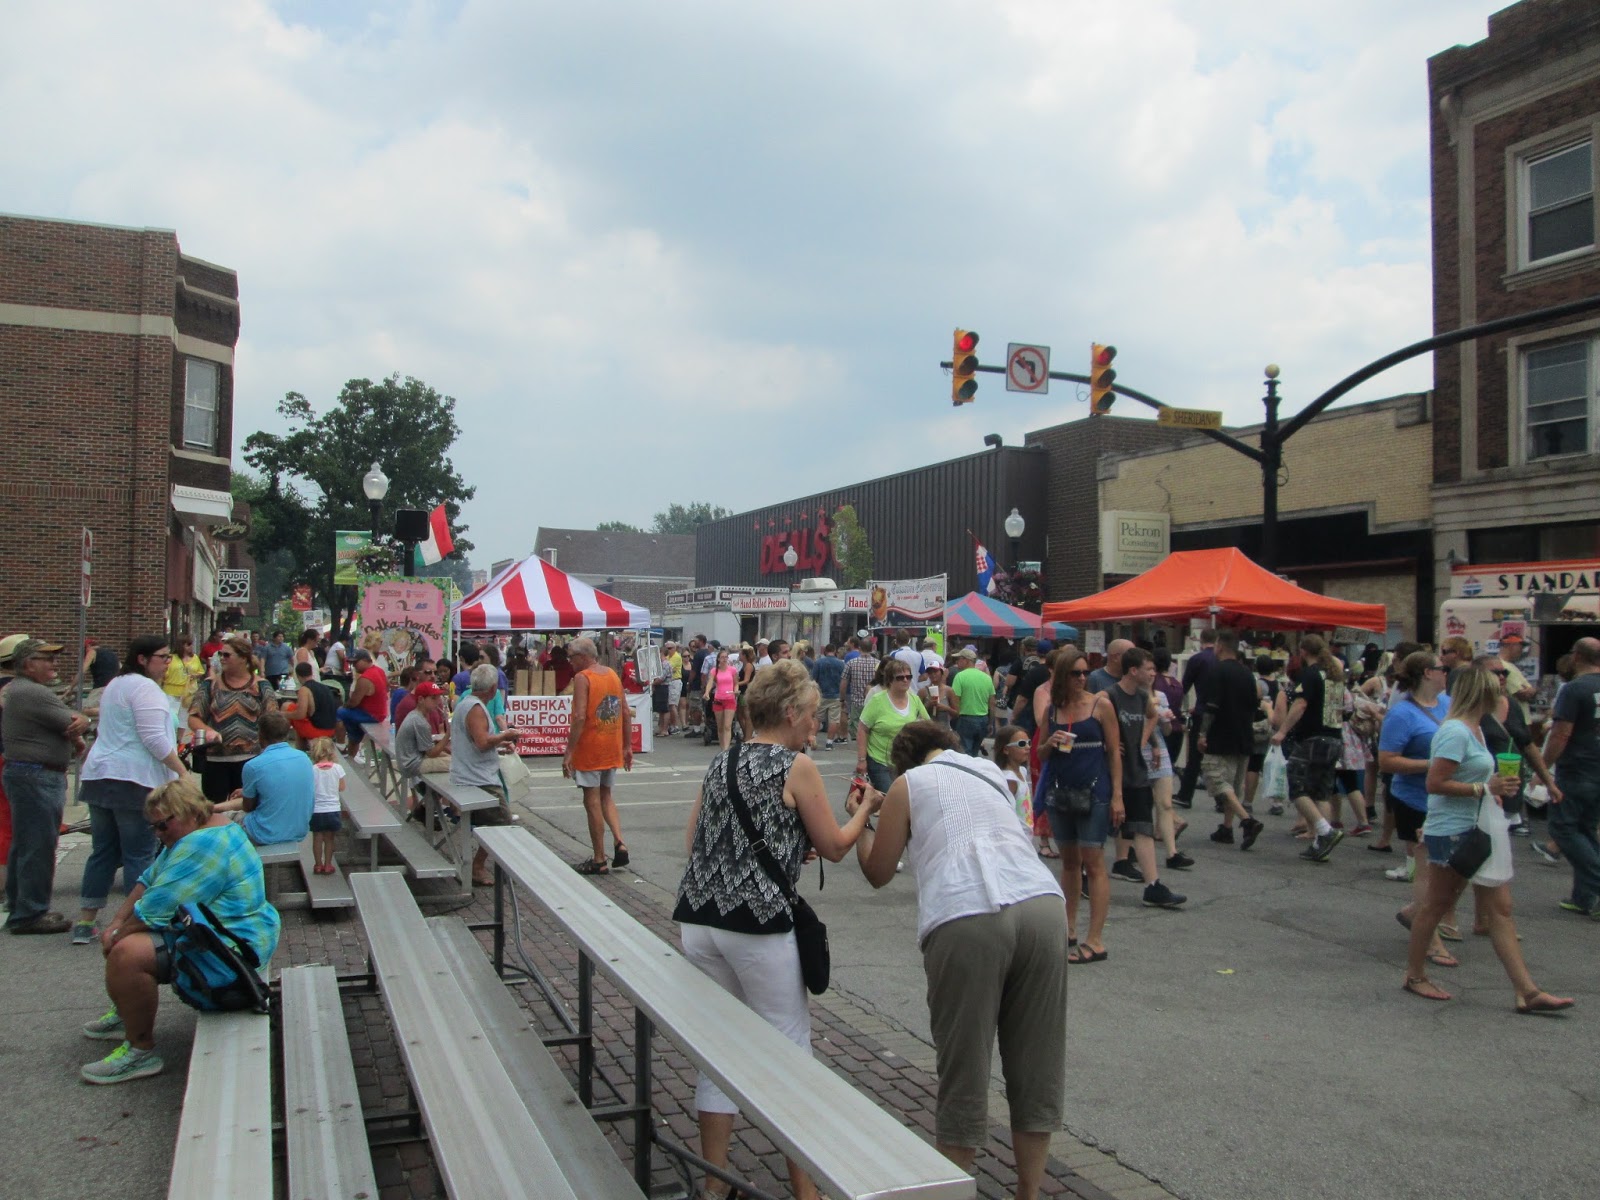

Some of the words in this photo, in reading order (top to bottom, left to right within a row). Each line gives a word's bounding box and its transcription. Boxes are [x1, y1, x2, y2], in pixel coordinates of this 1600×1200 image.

[1174, 410, 1211, 425] SHERIDAN
[1121, 522, 1161, 537] Pekron
[219, 580, 248, 598] 659
[768, 597, 787, 608] Pretzels
[506, 697, 571, 711] ABUSHKA'
[505, 714, 535, 726] LISH
[545, 736, 568, 744] CABBA
